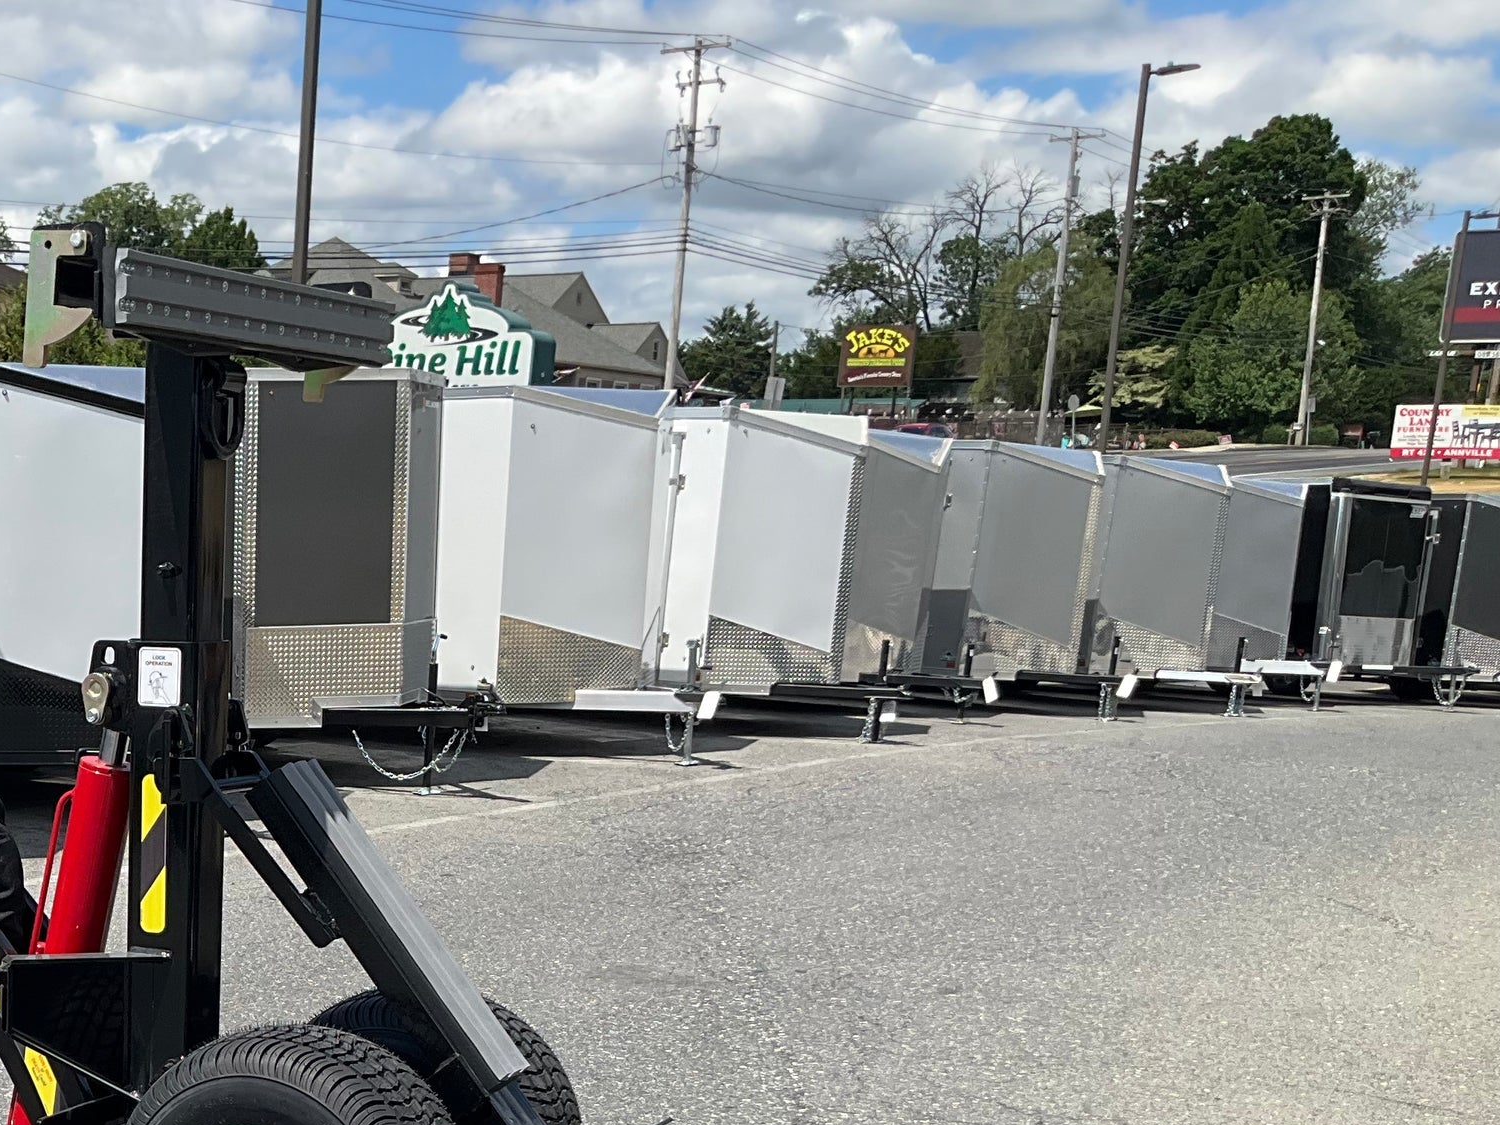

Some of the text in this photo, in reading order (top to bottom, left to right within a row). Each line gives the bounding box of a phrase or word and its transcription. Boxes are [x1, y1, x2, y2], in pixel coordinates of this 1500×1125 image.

[1469, 281, 1500, 296] EX
[845, 328, 911, 354] JAKE'S
[388, 340, 522, 376] ine Hill
[1399, 407, 1453, 417] COUNRY
[1409, 416, 1439, 426] LAN
[1401, 449, 1415, 457] RT
[1443, 449, 1494, 457] ANNVILLE
